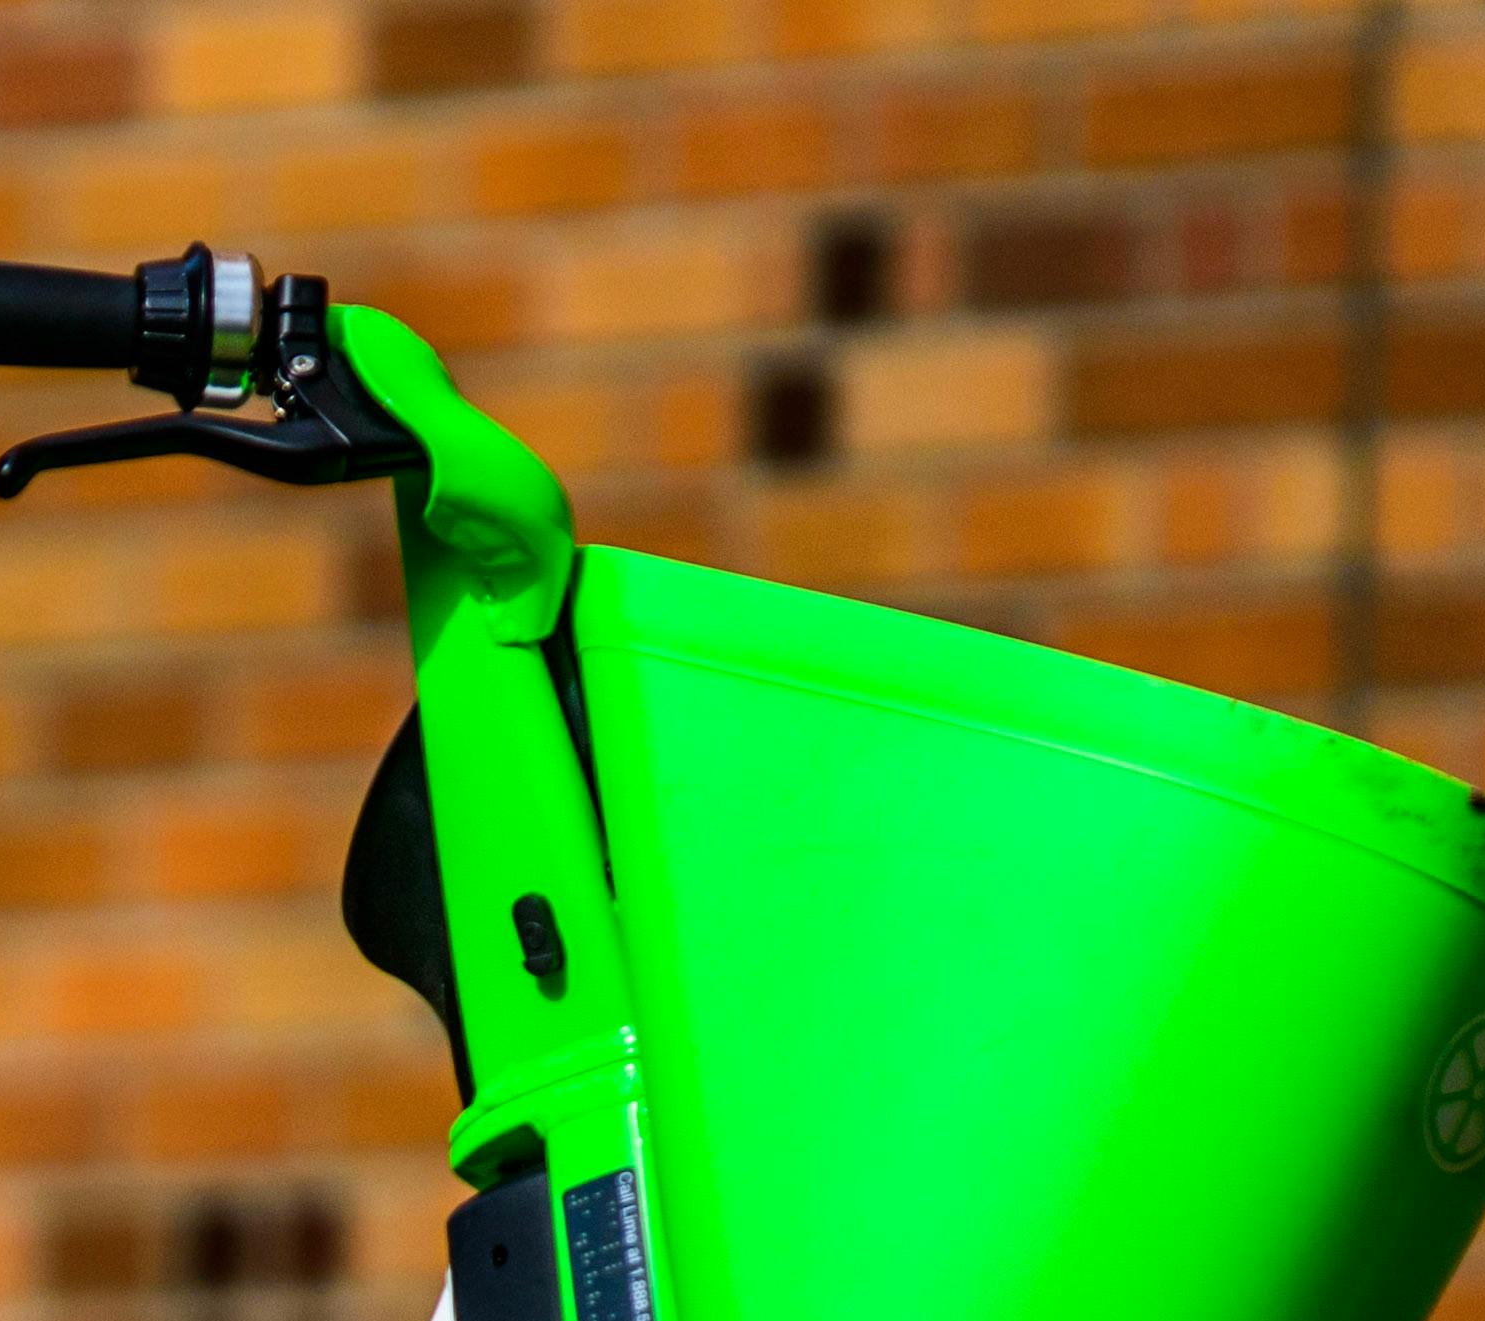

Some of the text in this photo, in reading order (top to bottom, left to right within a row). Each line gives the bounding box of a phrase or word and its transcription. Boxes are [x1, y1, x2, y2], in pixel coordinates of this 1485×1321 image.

[618, 1171, 635, 1203] Call
[621, 1205, 638, 1244] Lime
[627, 1247, 643, 1265] at
